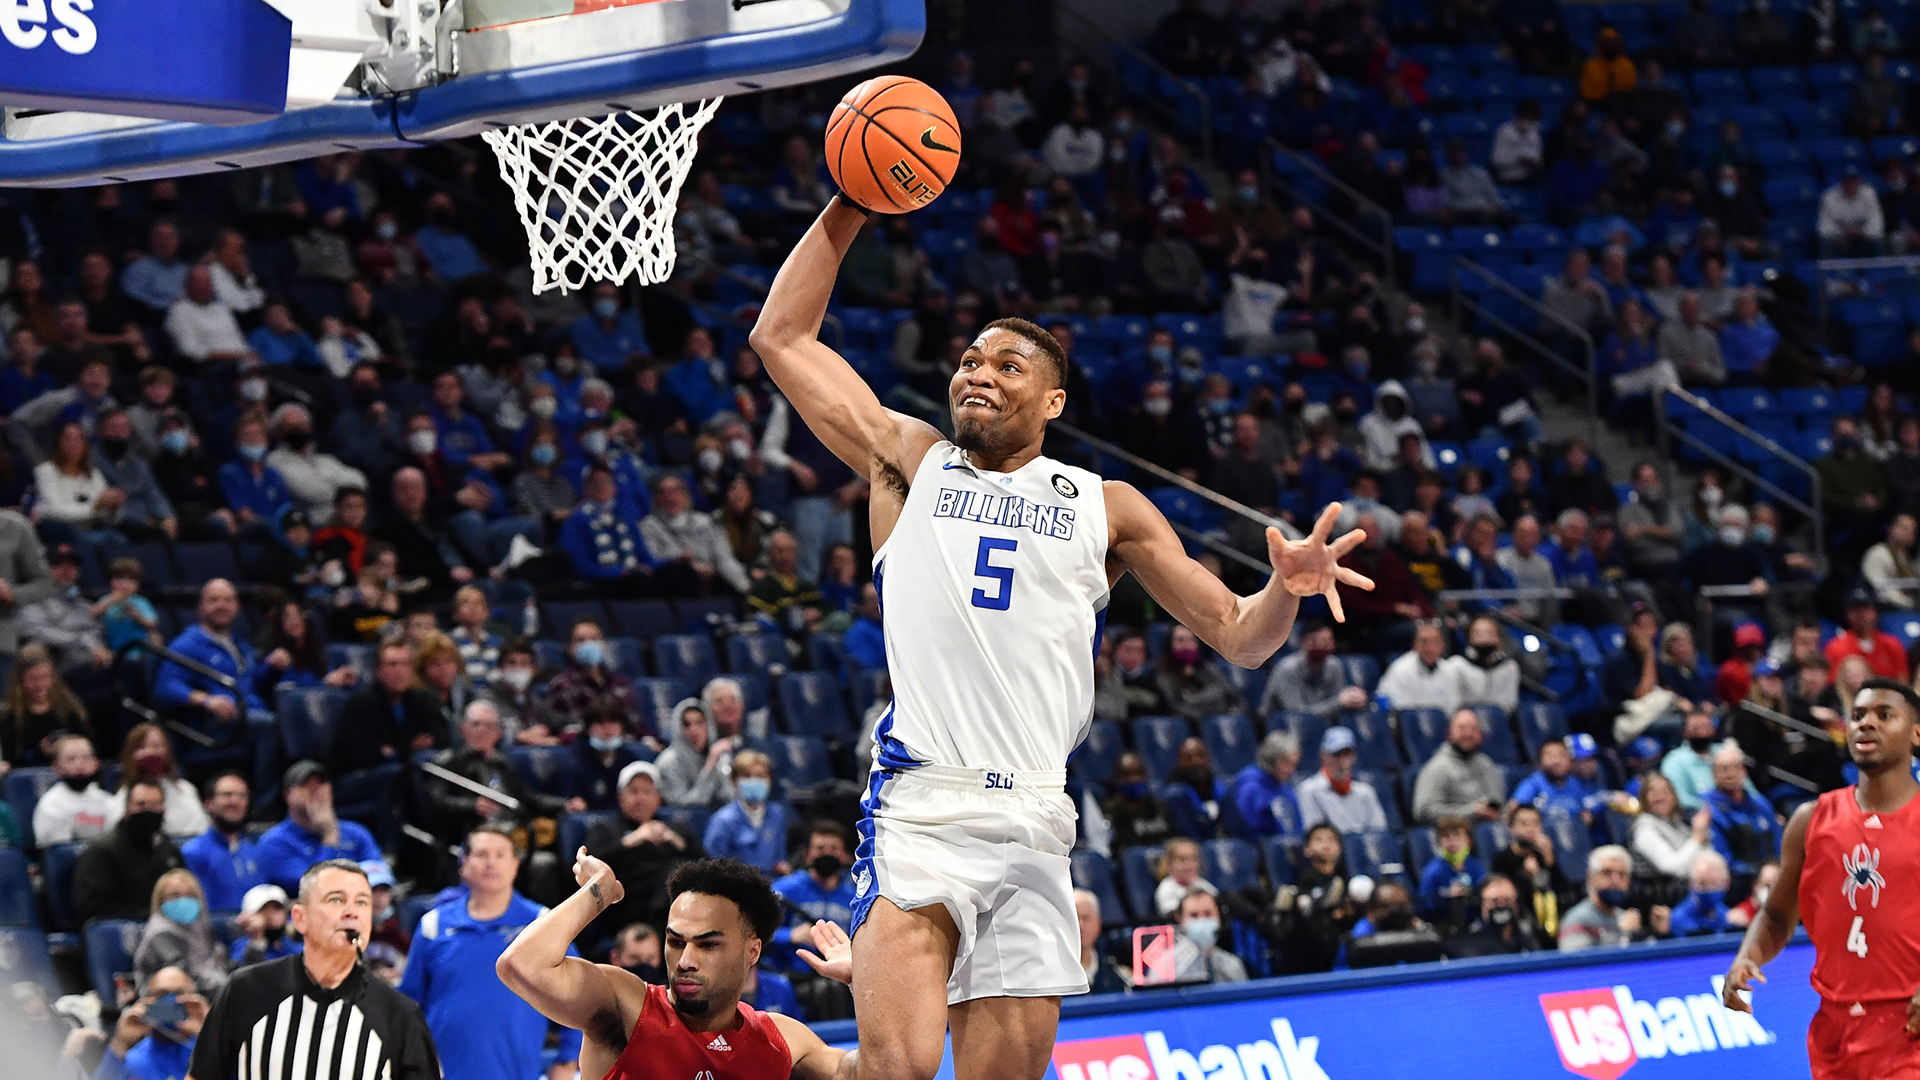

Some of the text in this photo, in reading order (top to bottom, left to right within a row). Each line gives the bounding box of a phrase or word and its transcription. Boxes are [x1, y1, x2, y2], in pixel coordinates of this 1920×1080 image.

[0, 0, 97, 54] es
[889, 159, 937, 204] ELITE
[933, 487, 1076, 541] BILLIKENS
[971, 536, 1018, 611] 5
[985, 772, 1014, 790] SLU
[1847, 916, 1868, 958] 4
